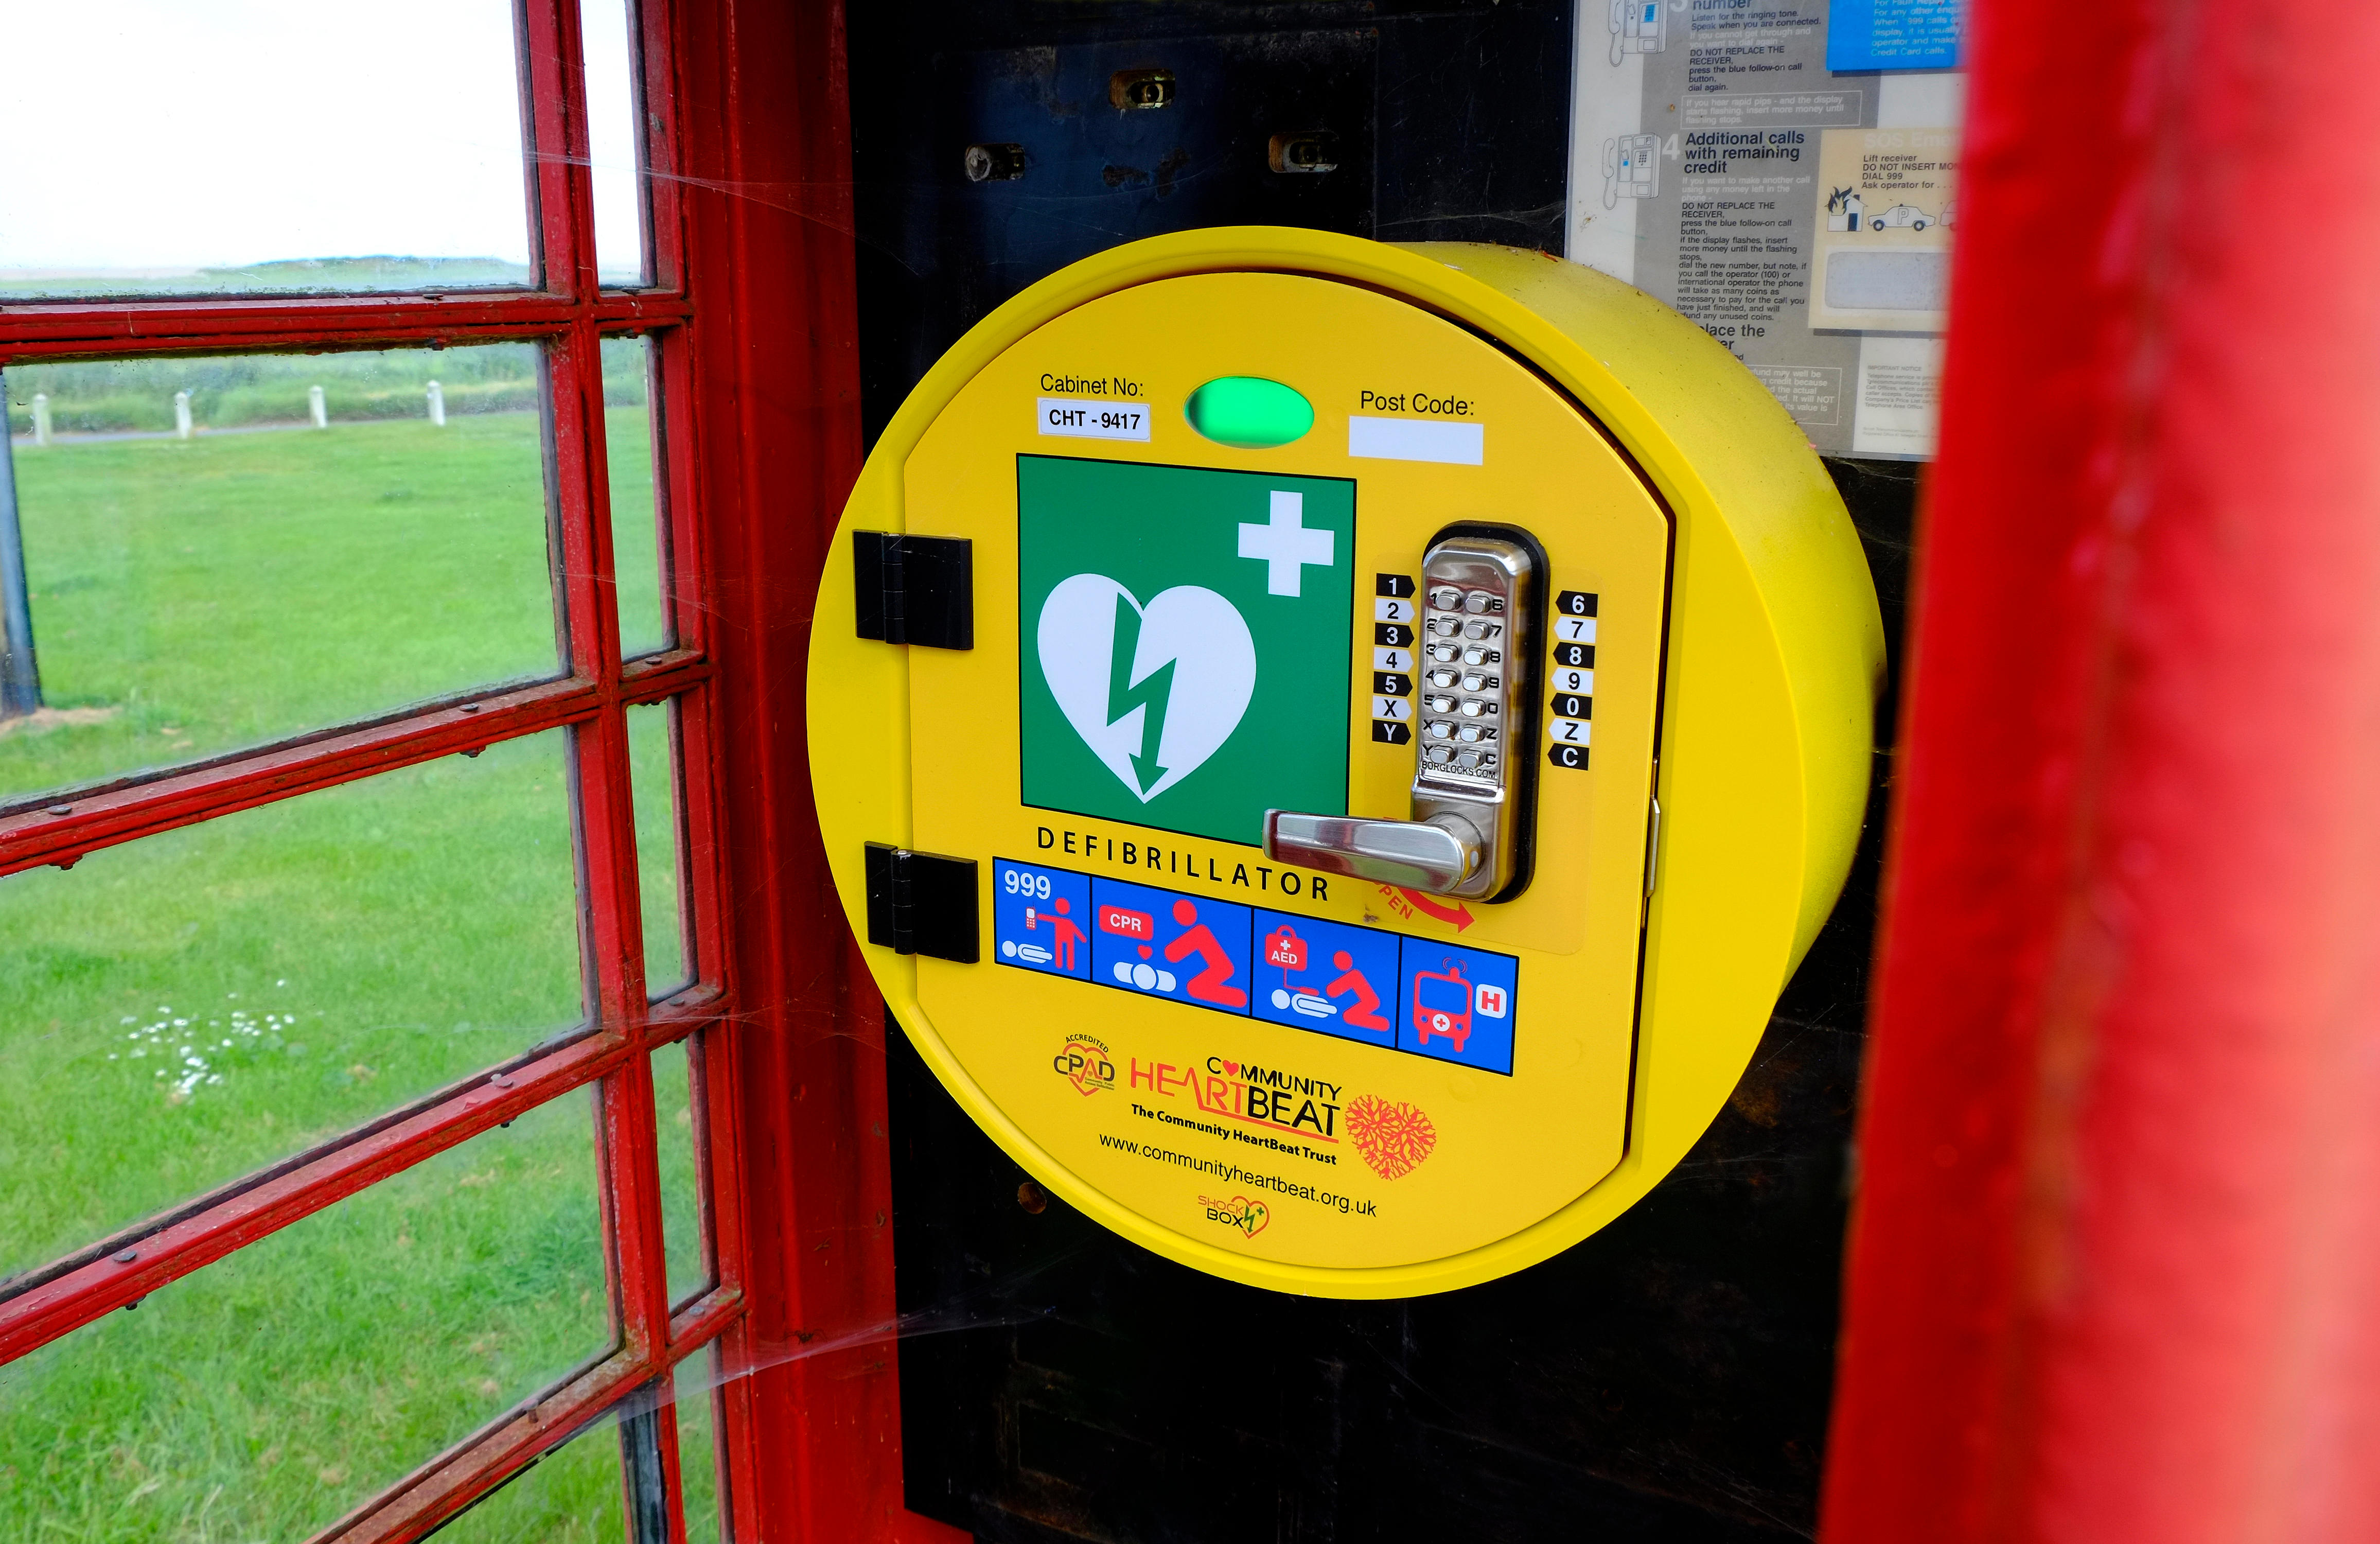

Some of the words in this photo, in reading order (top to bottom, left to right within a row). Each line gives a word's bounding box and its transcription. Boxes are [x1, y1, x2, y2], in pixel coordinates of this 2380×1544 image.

[1691, 23, 1716, 31] Speak
[1743, 21, 1758, 30] you
[1776, 17, 1821, 26] connected.
[1748, 11, 1776, 20] ringing
[1686, 132, 1763, 145] Additional
[1769, 131, 1805, 144] calls
[1662, 134, 1680, 161] 4
[1685, 148, 1712, 160] with
[1722, 146, 1800, 161] remaining
[1684, 161, 1727, 173] credit
[1881, 182, 1918, 190] operator
[1766, 245, 1797, 254] flashing
[1726, 271, 1758, 279] operator
[1741, 324, 1765, 337] the
[1041, 374, 1107, 395] Cabinet
[1113, 378, 1144, 397] No:
[1361, 391, 1405, 412] Post
[1413, 394, 1475, 415] Code:
[1049, 410, 1086, 428] CHT
[1102, 413, 1141, 430] 9417
[1389, 578, 1397, 594] 1
[1387, 603, 1399, 619] 2
[1492, 599, 1503, 610] 6
[1572, 595, 1585, 613] 6
[1427, 619, 1437, 629] 2
[1491, 625, 1502, 637] 7
[1571, 621, 1583, 638] 7
[1387, 627, 1398, 644] 3
[1426, 644, 1436, 655] 3
[1490, 652, 1500, 662] 8
[1570, 647, 1582, 664] 8
[1386, 652, 1398, 668] 4
[1385, 676, 1397, 693] 5
[1489, 677, 1499, 688] 9
[1568, 673, 1580, 690] 9
[1384, 700, 1397, 717] X
[1567, 698, 1579, 715] 0
[1384, 724, 1398, 741] Y
[1423, 720, 1434, 730] X
[1564, 723, 1578, 741] Z
[1486, 728, 1497, 740] Z
[1422, 745, 1433, 756] Y
[1486, 754, 1496, 764] C
[1563, 748, 1578, 766] C
[1037, 827, 1329, 901] DEFIBRILLATOR
[1004, 869, 1050, 899] 999
[1373, 882, 1413, 920] PEN
[1110, 914, 1142, 932] CPR
[1271, 950, 1297, 965] AED
[1482, 991, 1500, 1012] H
[1066, 1034, 1108, 1052] ACCREDITED
[1054, 1054, 1115, 1083] CPAD
[1132, 1104, 1154, 1118] The
[1157, 1111, 1230, 1139] Community
[1233, 1130, 1299, 1156] HeartBeat
[1302, 1147, 1336, 1165] Trust
[1099, 1134, 1377, 1218] www.communityheartbeat.org.uk
[1198, 1195, 1244, 1215] SHOCK
[1207, 1208, 1244, 1228] BOX
